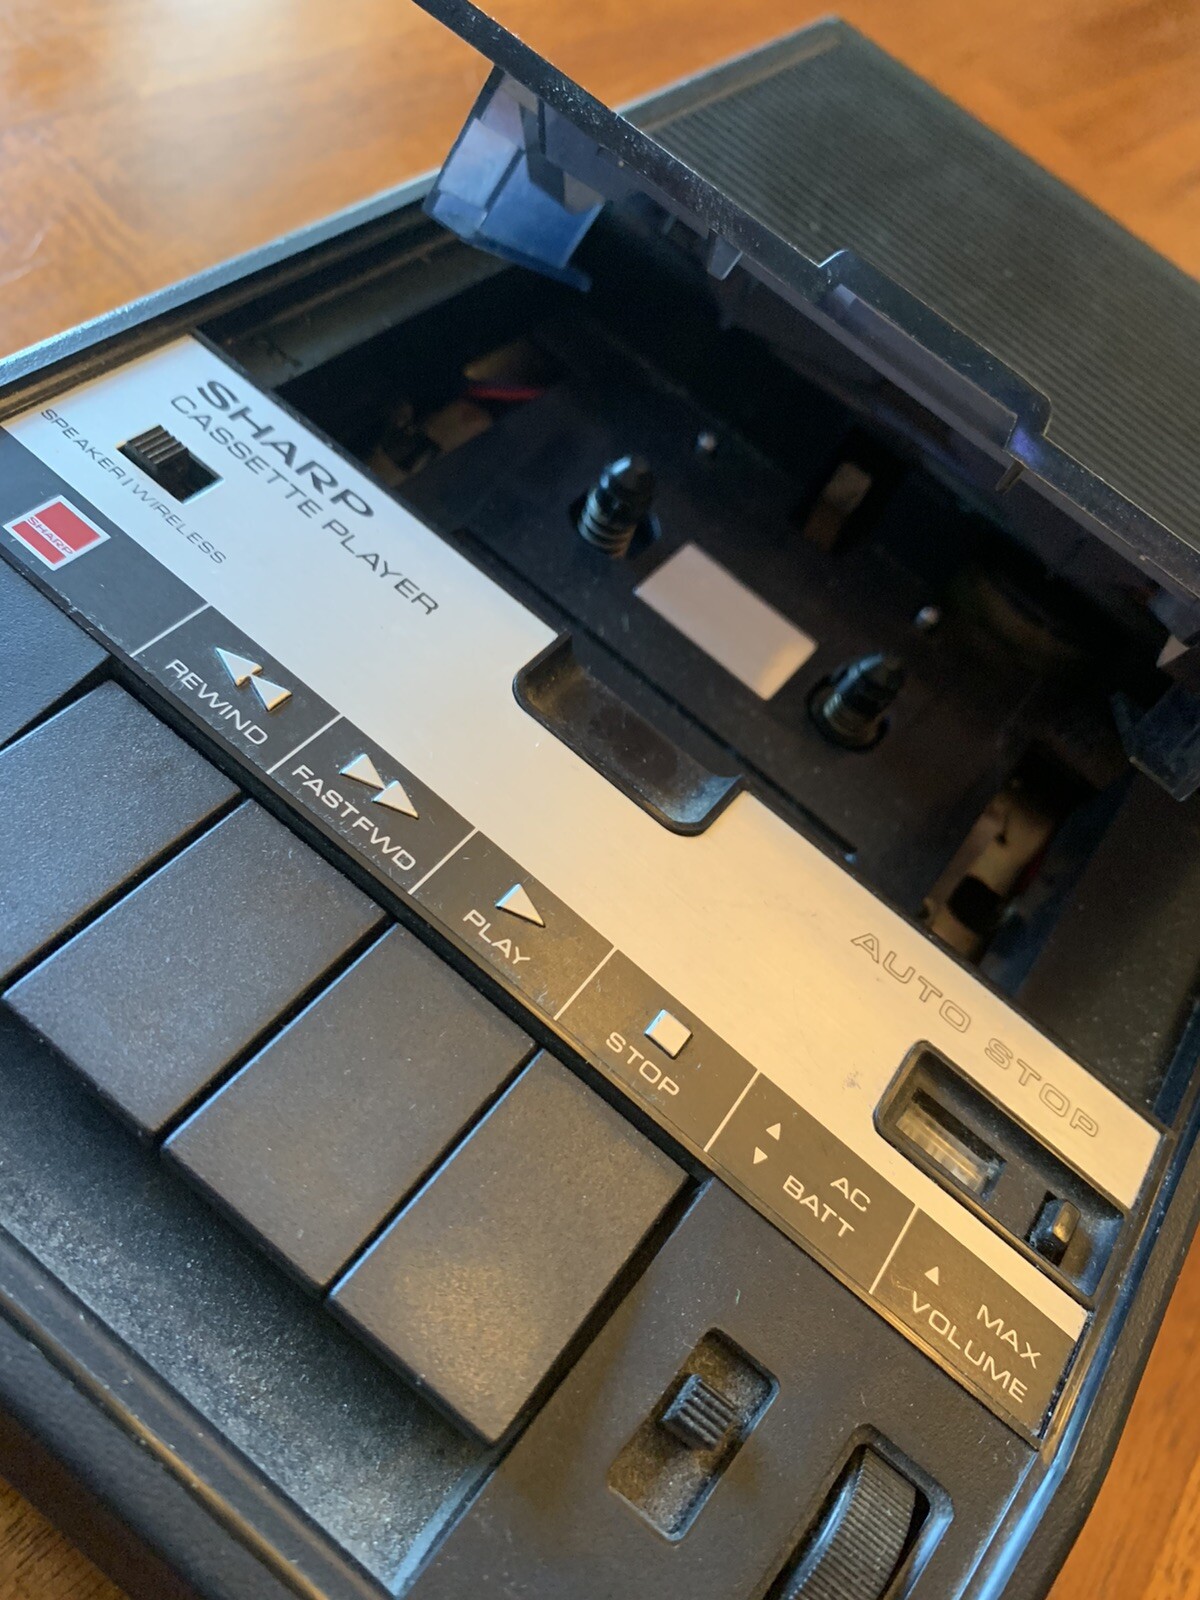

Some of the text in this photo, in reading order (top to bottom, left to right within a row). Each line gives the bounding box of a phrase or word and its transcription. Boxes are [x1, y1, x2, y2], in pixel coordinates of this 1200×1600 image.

[198, 380, 374, 518] SHARP
[27, 516, 73, 554] SHARP
[171, 395, 439, 615] CASSETTE PLAYER
[165, 659, 268, 745] REWIND
[462, 909, 531, 965] PLAY
[605, 1031, 681, 1096] STOP
[851, 932, 1099, 1138] AUTO STOP
[782, 1175, 855, 1237] BATT
[830, 1177, 871, 1212] AC
[911, 1290, 1028, 1403] VOLUME
[976, 1304, 1042, 1369] MAX
